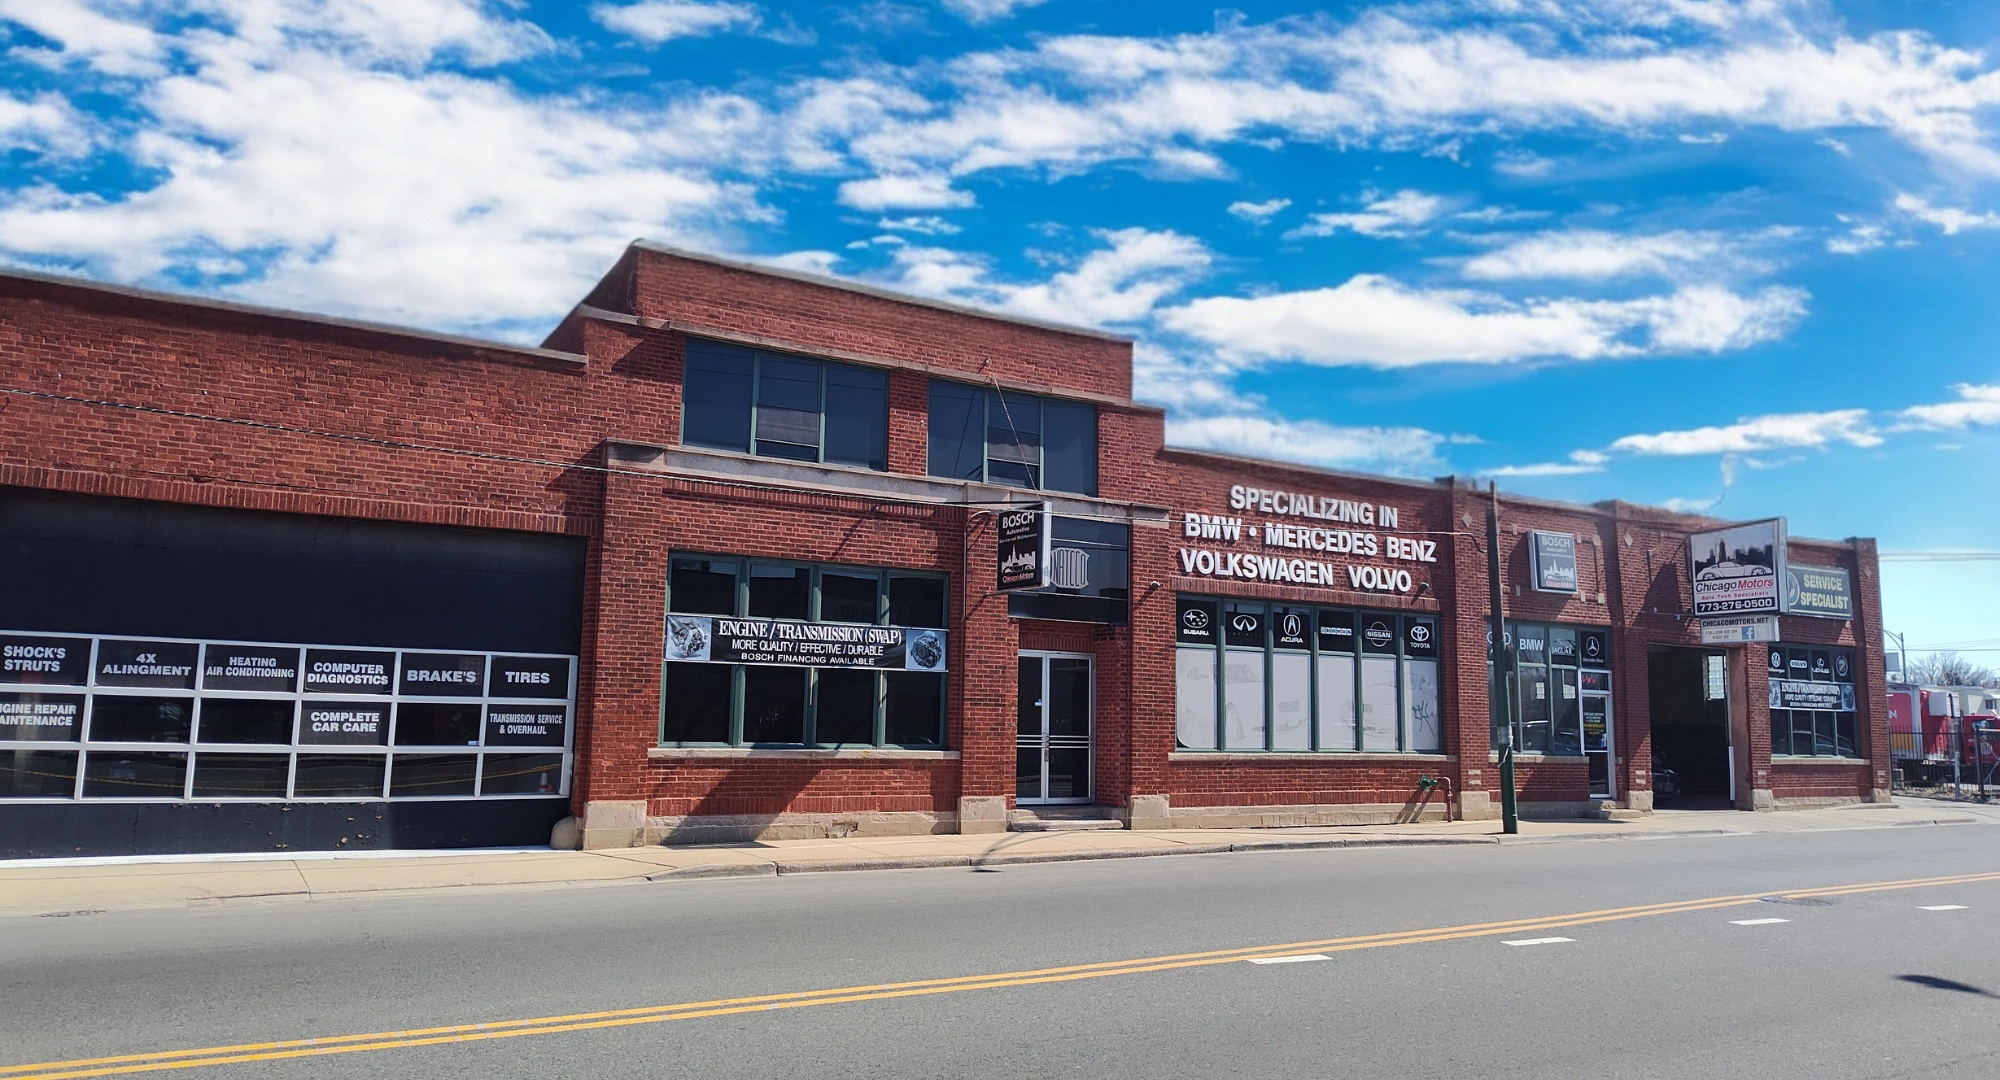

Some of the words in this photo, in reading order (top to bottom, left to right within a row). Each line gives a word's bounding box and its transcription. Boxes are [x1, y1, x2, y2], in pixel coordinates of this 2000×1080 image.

[1230, 485, 1374, 525] SPECIALIZING
[1379, 505, 1398, 528] IN
[1002, 512, 1034, 528] BOSCH
[1006, 526, 1030, 535] Automotive
[1185, 513, 1241, 541] BMW
[1265, 522, 1377, 556] MERCEDES
[1386, 536, 1437, 563] BENZ
[1542, 536, 1570, 548] BOSCH
[1180, 548, 1333, 586] VOLKSWAGEN
[1348, 566, 1412, 592] VOLVO
[1804, 574, 1842, 591] SERVICE
[1700, 599, 1772, 611] 773-276-0500
[1800, 592, 1848, 609] SPECIALIST
[1703, 617, 1769, 627] CHICAGOMOTORS.NET
[718, 620, 768, 637] ENGINE
[777, 624, 866, 642] TRANSMISSION
[865, 628, 901, 646] (SWAP)
[732, 639, 757, 650] MORE
[759, 640, 794, 652] QUALITY
[800, 643, 841, 654] EFFECTIVE
[847, 645, 883, 656] DURABLE
[1520, 639, 1544, 651] BMW
[3, 645, 66, 659] SHOCK'S
[136, 653, 157, 664] 4X
[229, 657, 277, 667] HEATING
[741, 653, 774, 661] BOSCH
[778, 654, 826, 663] FINANCING
[829, 657, 875, 665] AVAILABLE
[4, 659, 61, 672] STRUTS
[102, 664, 192, 676] ALINGMENT
[314, 662, 384, 674] COMPUTER
[206, 667, 224, 676] AIR
[225, 667, 294, 678] CONDITIONING
[406, 670, 477, 683] BRAKE'S
[505, 671, 550, 684] TIRES
[307, 673, 388, 685] DIAGNOSTICS
[34, 704, 77, 714] REPAIR
[310, 712, 380, 722] COMPLETE
[490, 713, 535, 724] TRANSMISSION
[538, 714, 563, 724] SERVICE
[312, 722, 340, 732] CAR
[342, 723, 377, 733] CARE
[499, 725, 505, 734] &
[507, 725, 547, 735] OVERHAUL
